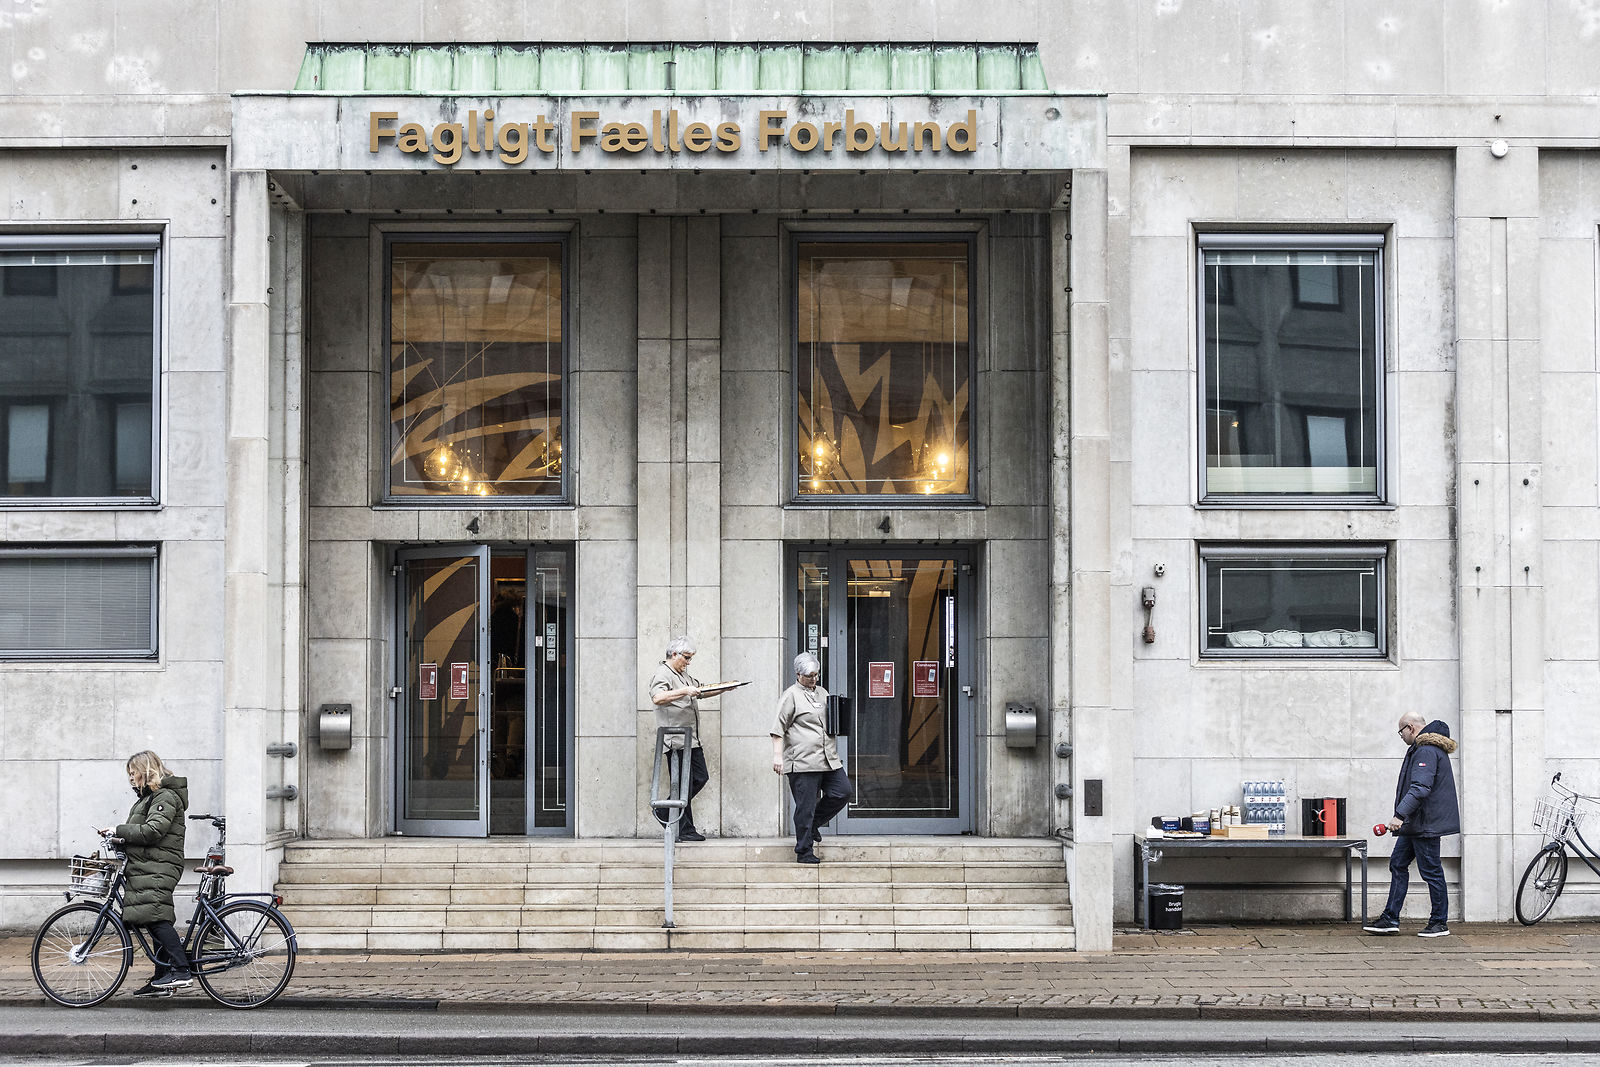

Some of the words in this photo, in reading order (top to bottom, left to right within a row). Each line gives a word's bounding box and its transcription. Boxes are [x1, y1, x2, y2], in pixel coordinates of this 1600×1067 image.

[369, 110, 555, 166] Fagligt
[571, 110, 742, 153] Fælles
[759, 110, 977, 153] Forbund
[878, 515, 891, 533] 4
